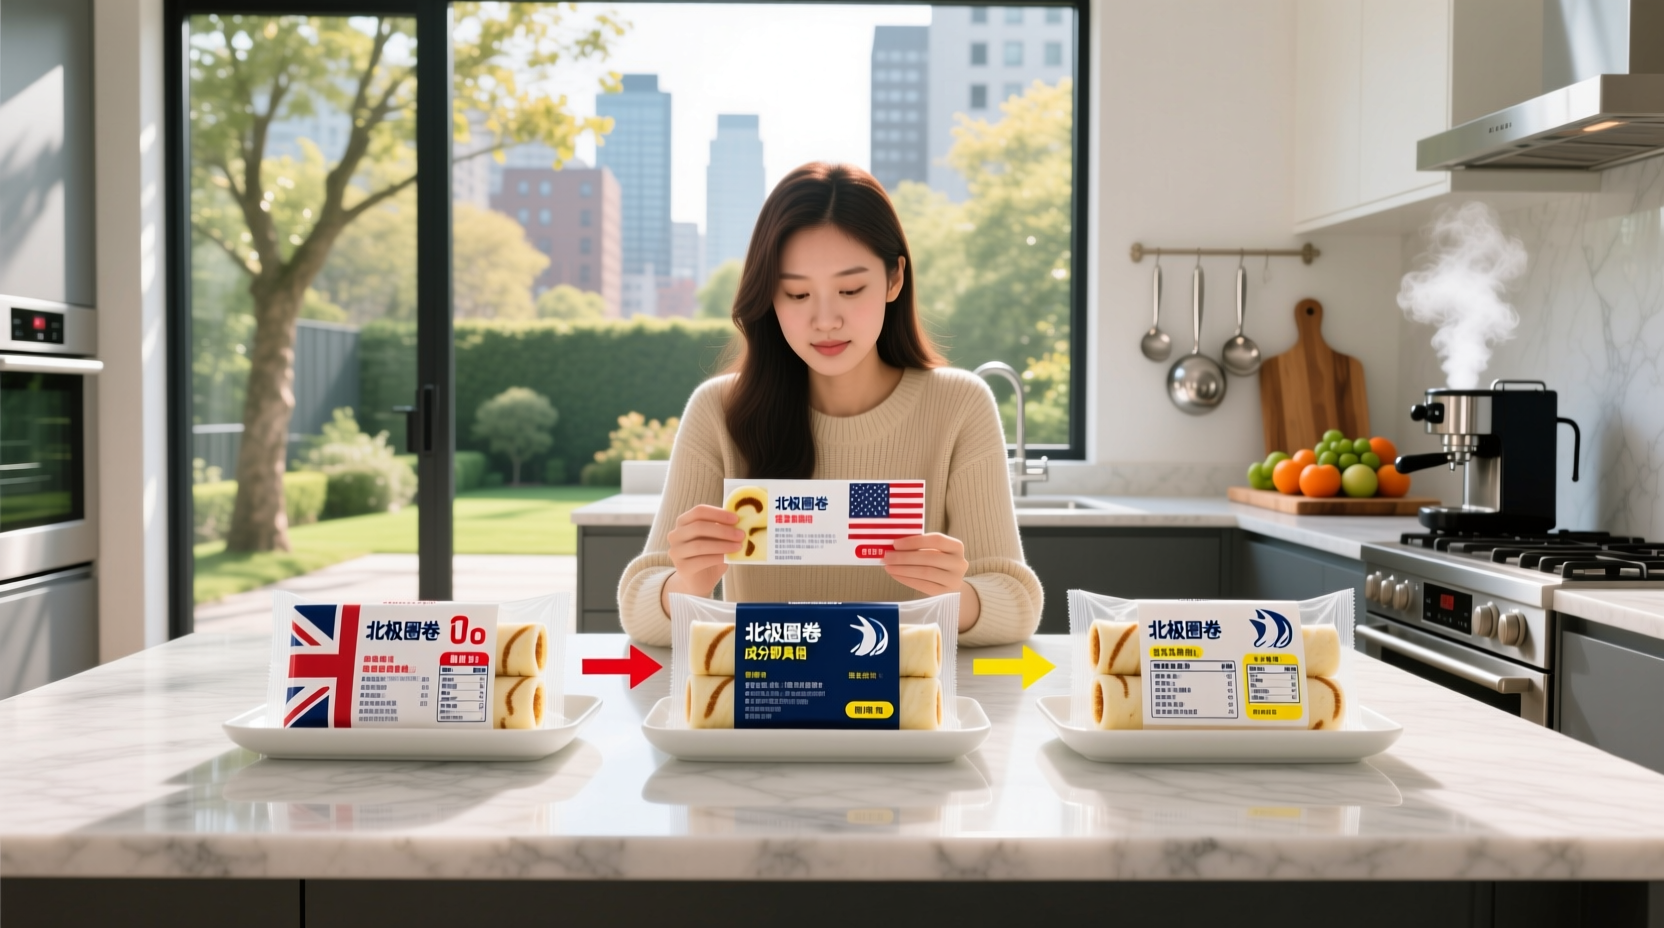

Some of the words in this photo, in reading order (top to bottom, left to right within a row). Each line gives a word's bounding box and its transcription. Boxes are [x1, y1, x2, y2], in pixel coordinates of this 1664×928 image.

[366, 620, 440, 641] 北极圈卷
[745, 622, 822, 643] 北极圈卷
[1148, 620, 1222, 640] 北极圈卷
